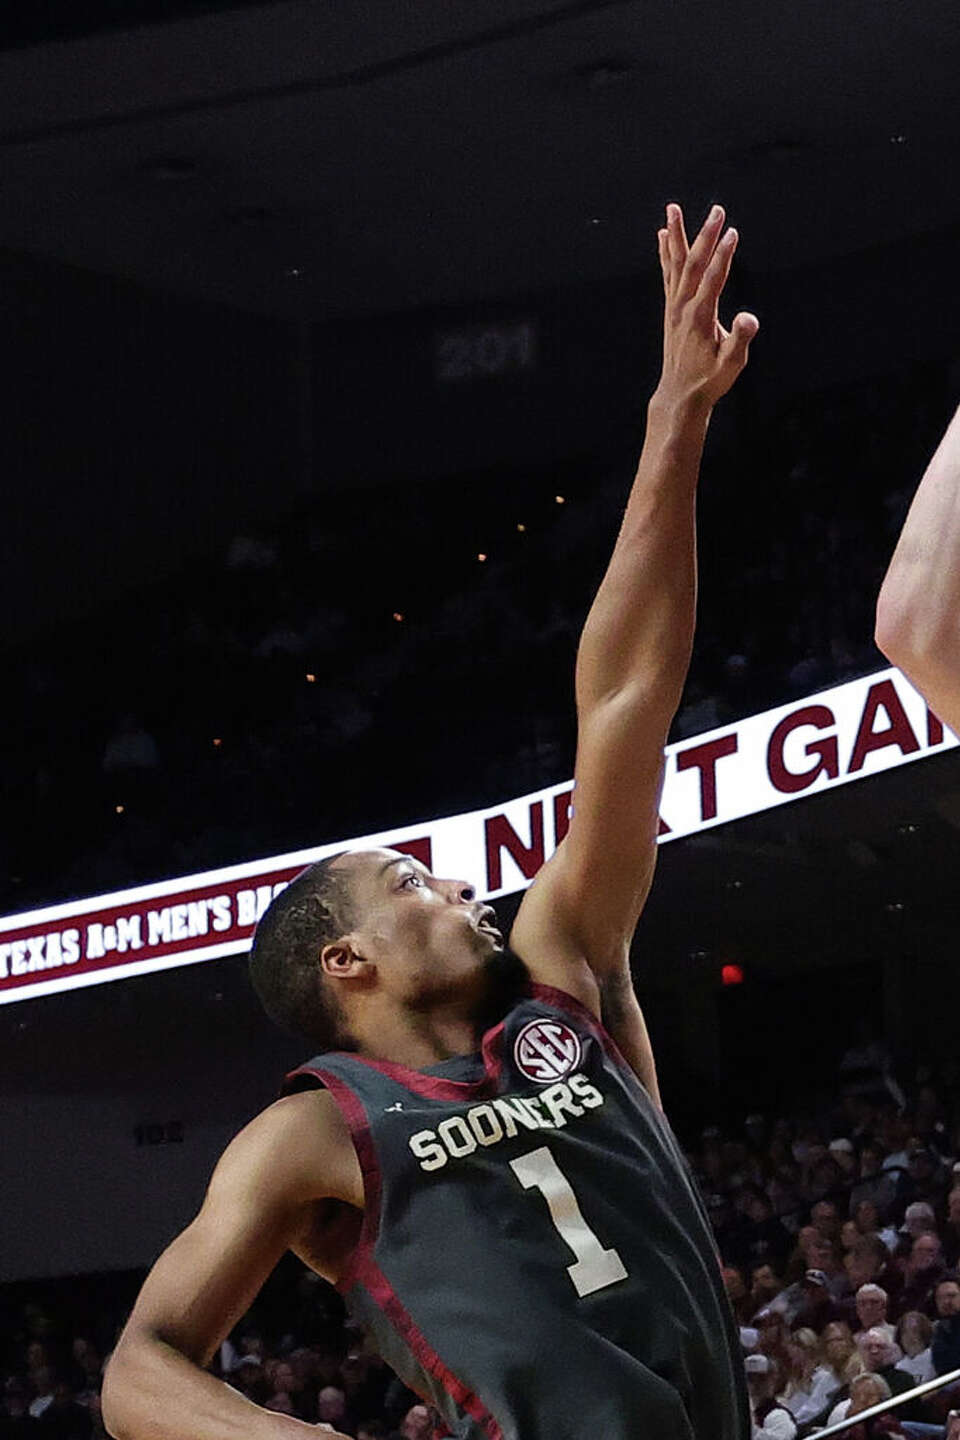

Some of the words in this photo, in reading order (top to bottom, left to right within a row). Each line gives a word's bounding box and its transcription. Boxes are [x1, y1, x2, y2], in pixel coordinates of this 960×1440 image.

[484, 733, 738, 893] NT
[0, 929, 81, 978] TEXAS
[147, 896, 231, 946] MEN'S
[236, 882, 289, 927] BA
[519, 1023, 576, 1078] SEC
[408, 1073, 603, 1171] SOONERS
[508, 1146, 629, 1298] 1
